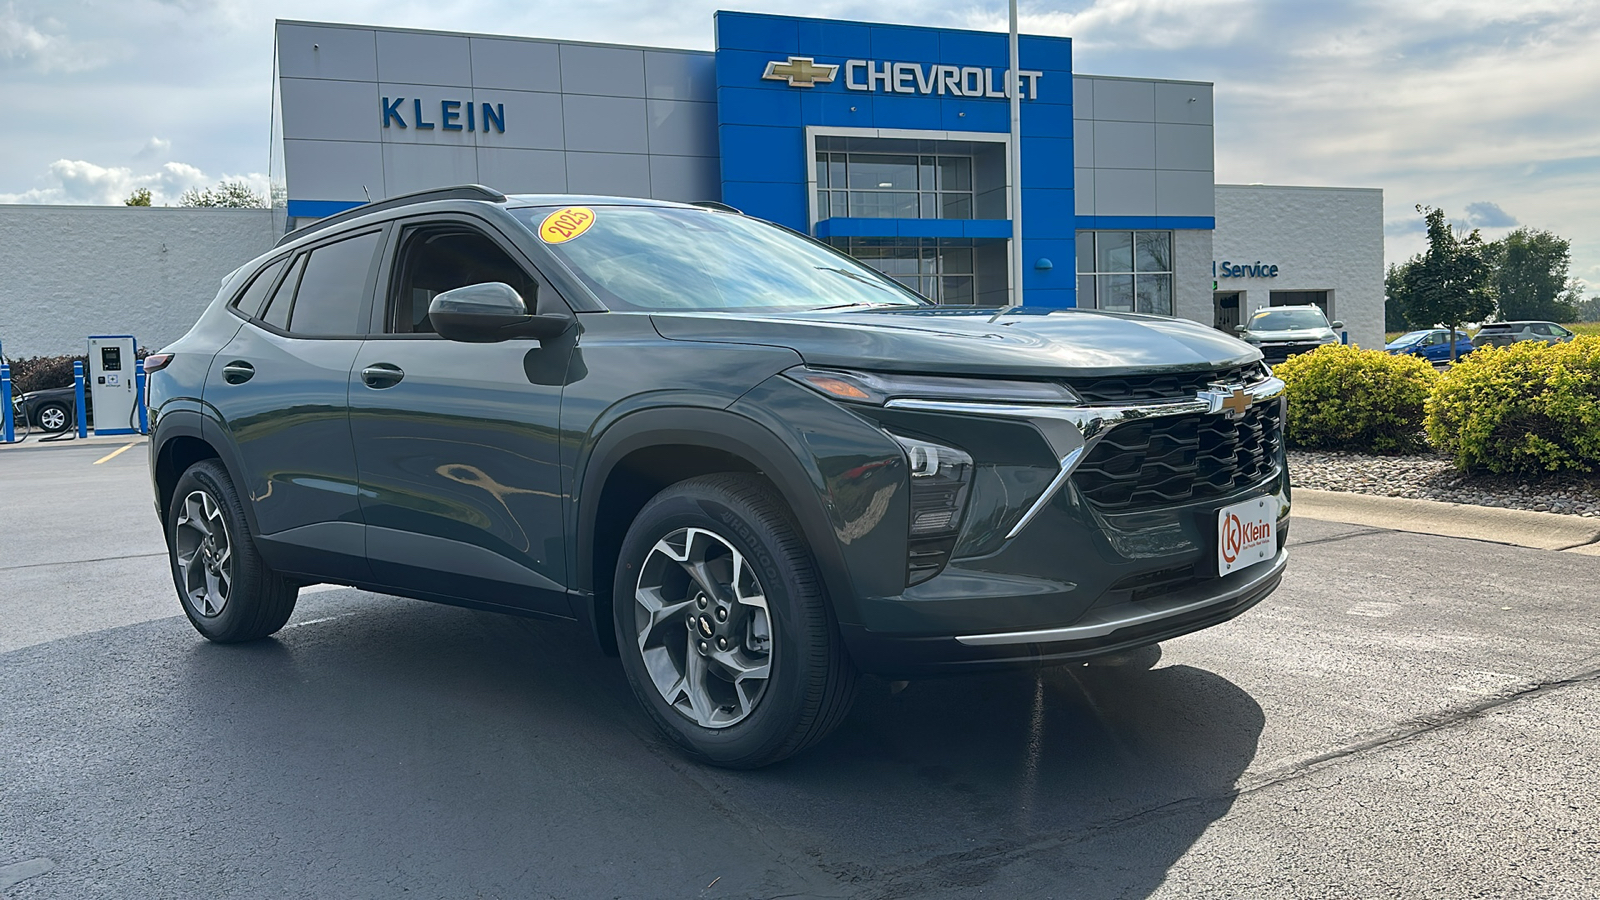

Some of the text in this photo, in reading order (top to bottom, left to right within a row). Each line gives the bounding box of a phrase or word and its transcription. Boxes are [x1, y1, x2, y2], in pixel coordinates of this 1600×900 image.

[845, 59, 1043, 100] CHEVROLET
[382, 97, 506, 133] KLEIN
[548, 209, 589, 238] 2025
[1222, 260, 1279, 278] Service
[1243, 519, 1270, 545] Klein
